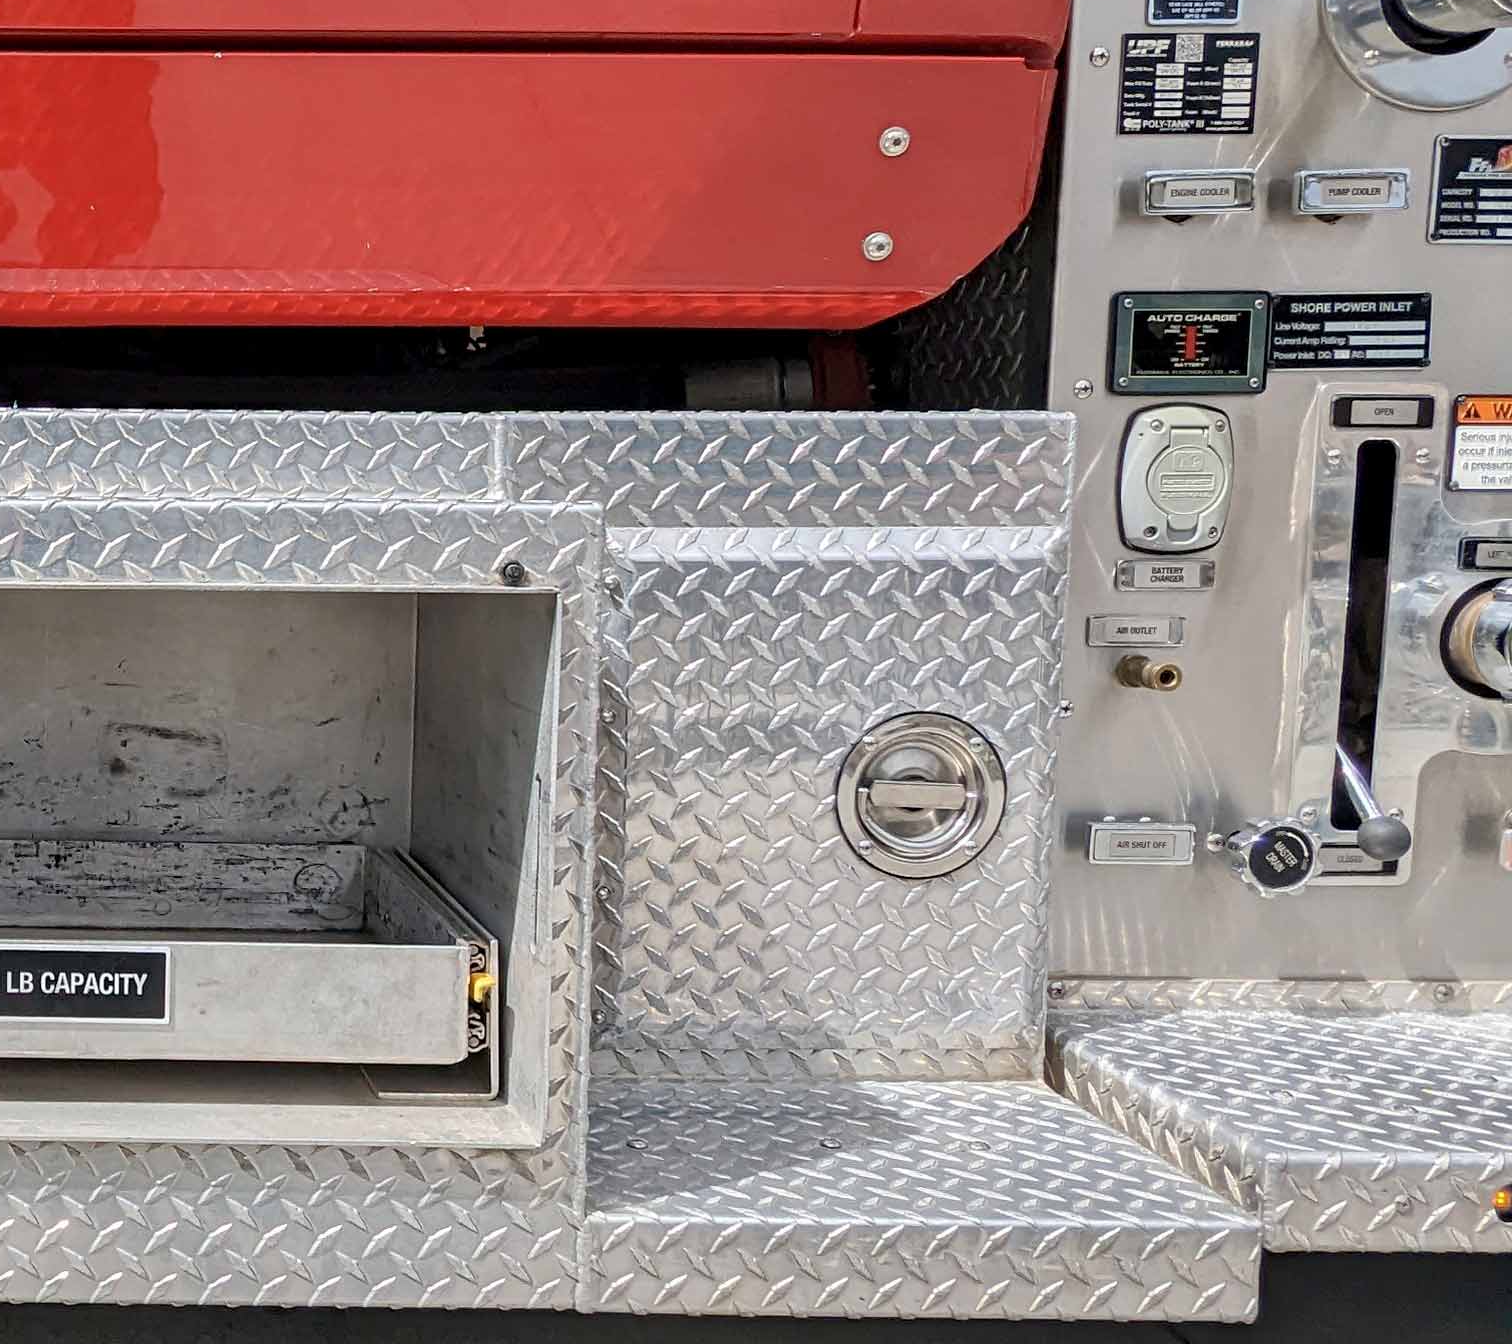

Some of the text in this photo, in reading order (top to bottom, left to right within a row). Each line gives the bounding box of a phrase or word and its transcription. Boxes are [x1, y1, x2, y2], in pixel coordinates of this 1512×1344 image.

[1170, 187, 1230, 198] ENGINE COOLER
[1328, 187, 1382, 197] PUMP COOLER
[1290, 301, 1413, 313] SHORE POWER INLET
[1147, 314, 1184, 322] AUTO
[1275, 322, 1290, 330] Line
[1274, 337, 1302, 345] Current
[1302, 337, 1319, 346] Amp
[1273, 351, 1297, 360] Power
[1374, 408, 1394, 416] OPEN
[1460, 432, 1496, 441] Serious
[1458, 448, 1486, 457] occur
[1487, 446, 1495, 456] if
[1481, 475, 1496, 484] the
[1150, 575, 1184, 583] CHARGER
[1115, 627, 1158, 635] AIR OUTLET
[1116, 840, 1168, 849] AIR SHUT OFF
[1274, 841, 1298, 868] MASTER
[1265, 852, 1286, 873] DRAIN
[6, 971, 34, 994] LB
[40, 971, 148, 996] CAPACITY
